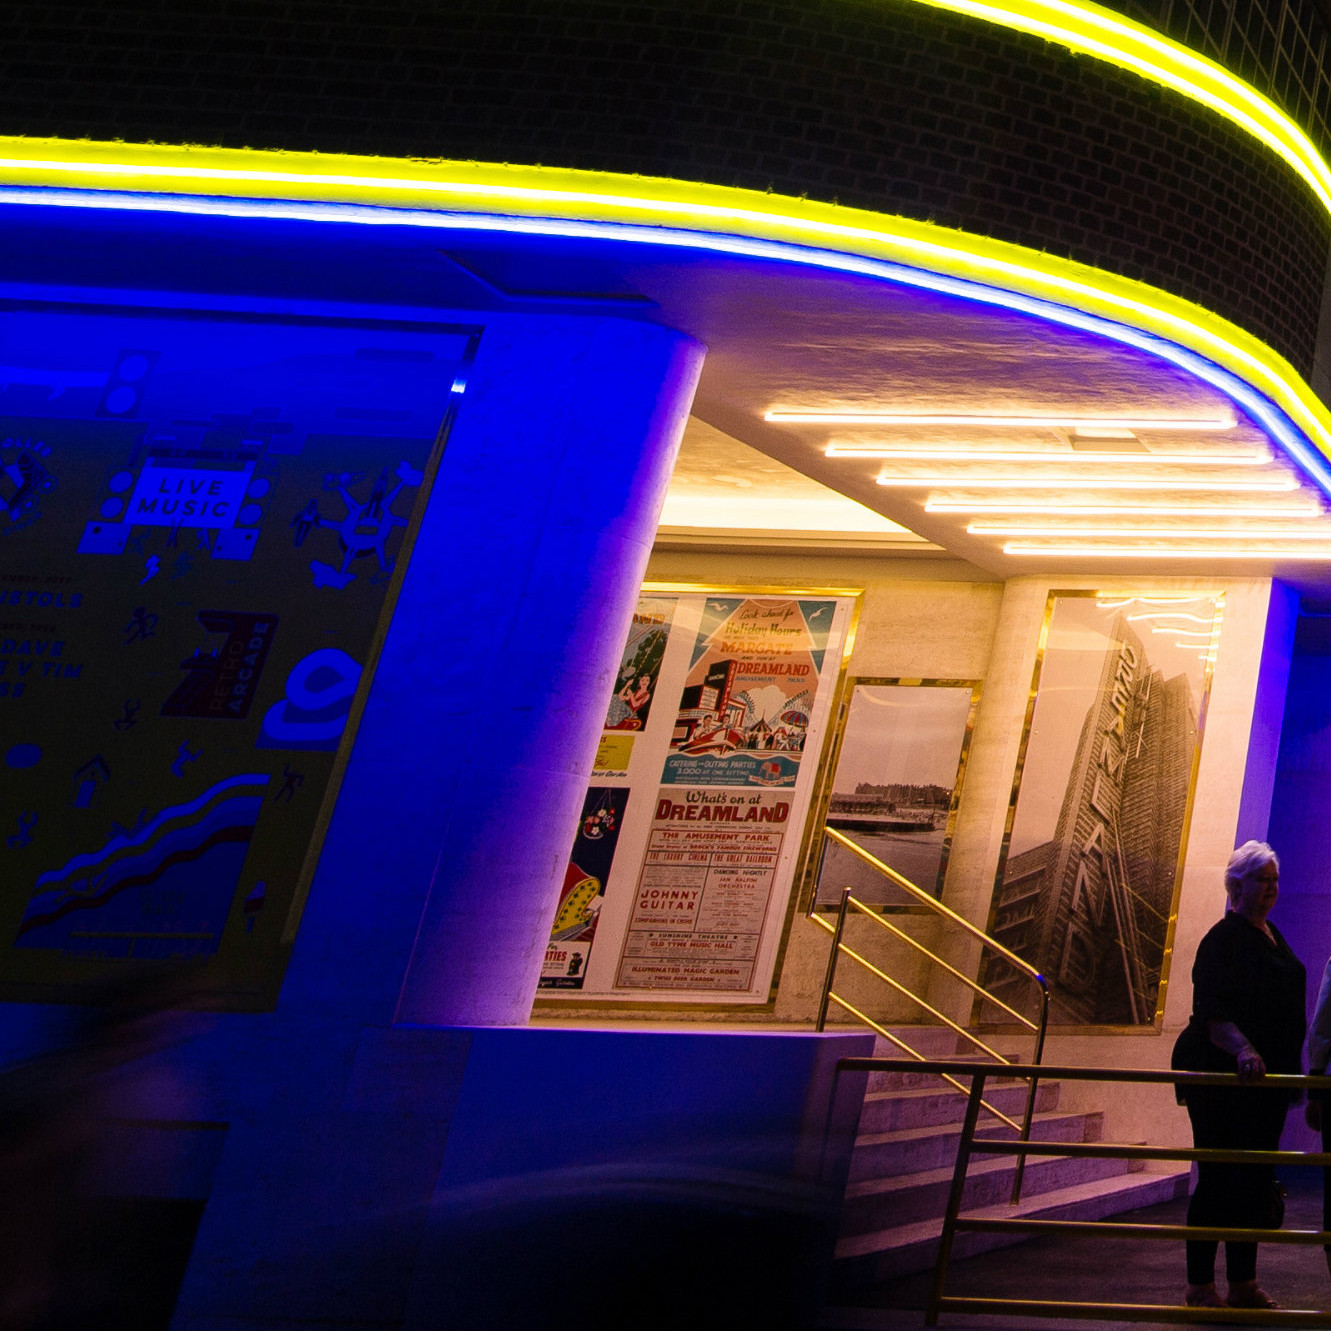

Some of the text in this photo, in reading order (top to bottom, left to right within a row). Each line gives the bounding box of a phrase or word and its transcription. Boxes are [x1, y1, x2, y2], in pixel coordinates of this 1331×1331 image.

[158, 477, 225, 498] LIVE
[136, 498, 231, 518] MUSIC
[725, 621, 803, 637] Holiday Hours
[0, 639, 65, 657] DAVE
[720, 641, 793, 655] MARGATE
[41, 663, 83, 678] TIM
[227, 622, 270, 715] ARCADE
[737, 662, 811, 676] DREAMLAND
[669, 759, 698, 768] CATERING
[731, 761, 757, 769] PARTIES
[686, 790, 762, 805] What's on at
[655, 799, 790, 823] DREAMLAND
[685, 833, 740, 841] AMUSEMENT
[745, 834, 770, 842] PARK
[688, 853, 708, 862] CINEMA
[714, 854, 772, 864] THE GREAT BALLROOM
[641, 889, 699, 900] JOHNNY
[640, 900, 695, 911] GUITAR
[632, 966, 680, 974] ILLUMINATED
